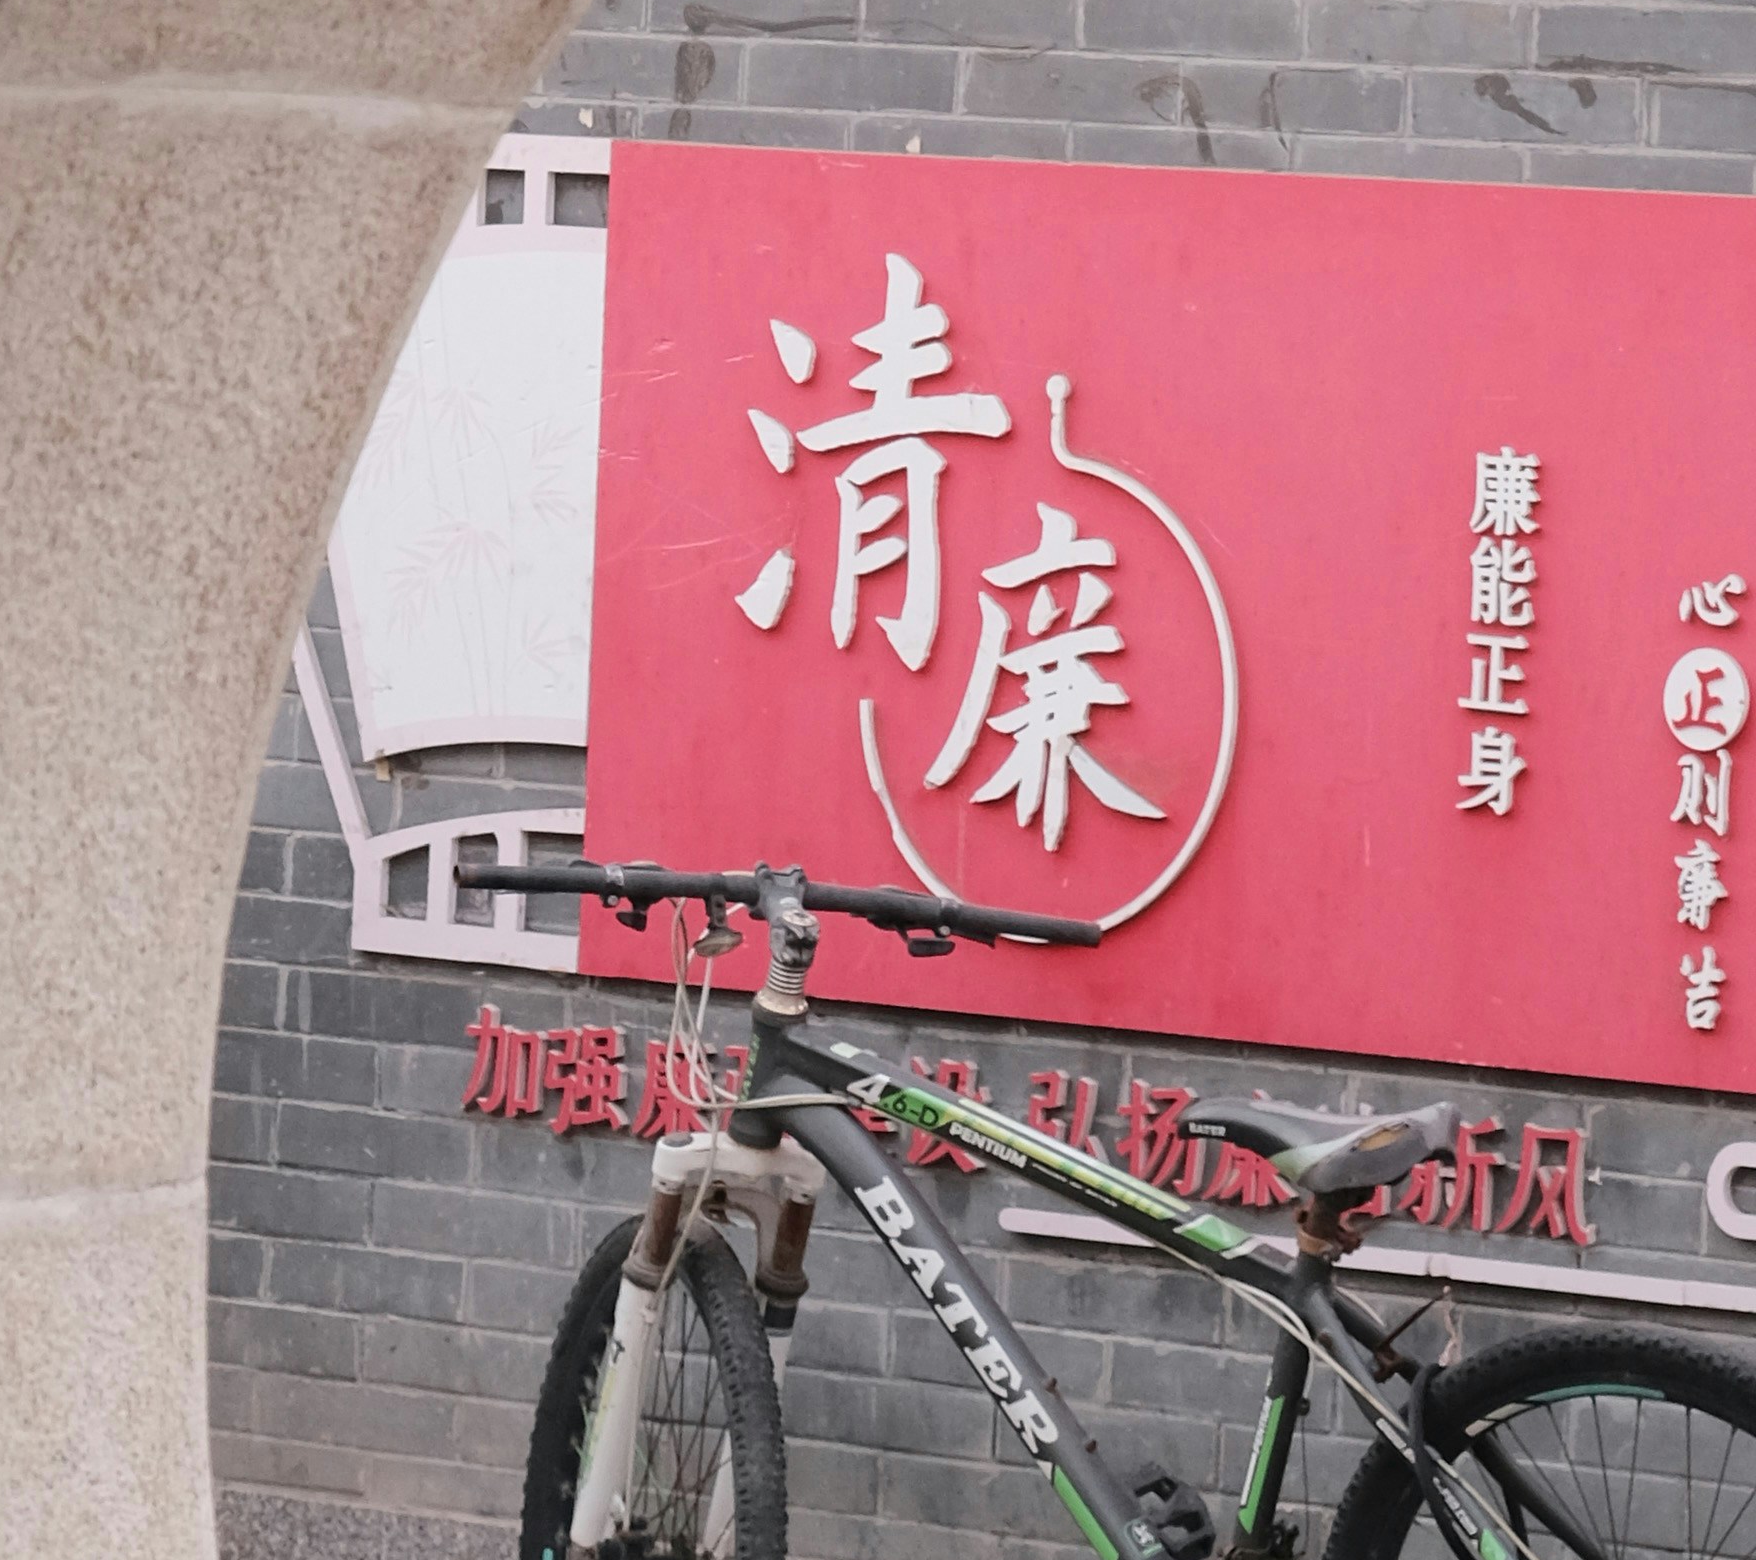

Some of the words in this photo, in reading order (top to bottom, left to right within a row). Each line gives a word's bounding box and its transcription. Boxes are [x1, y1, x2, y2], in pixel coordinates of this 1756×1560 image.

[735, 253, 1167, 853] 清廉
[1456, 446, 1540, 816] 廉能正身
[948, 1121, 1028, 1169] PENTIUM
[854, 1176, 1059, 1453] BATER
